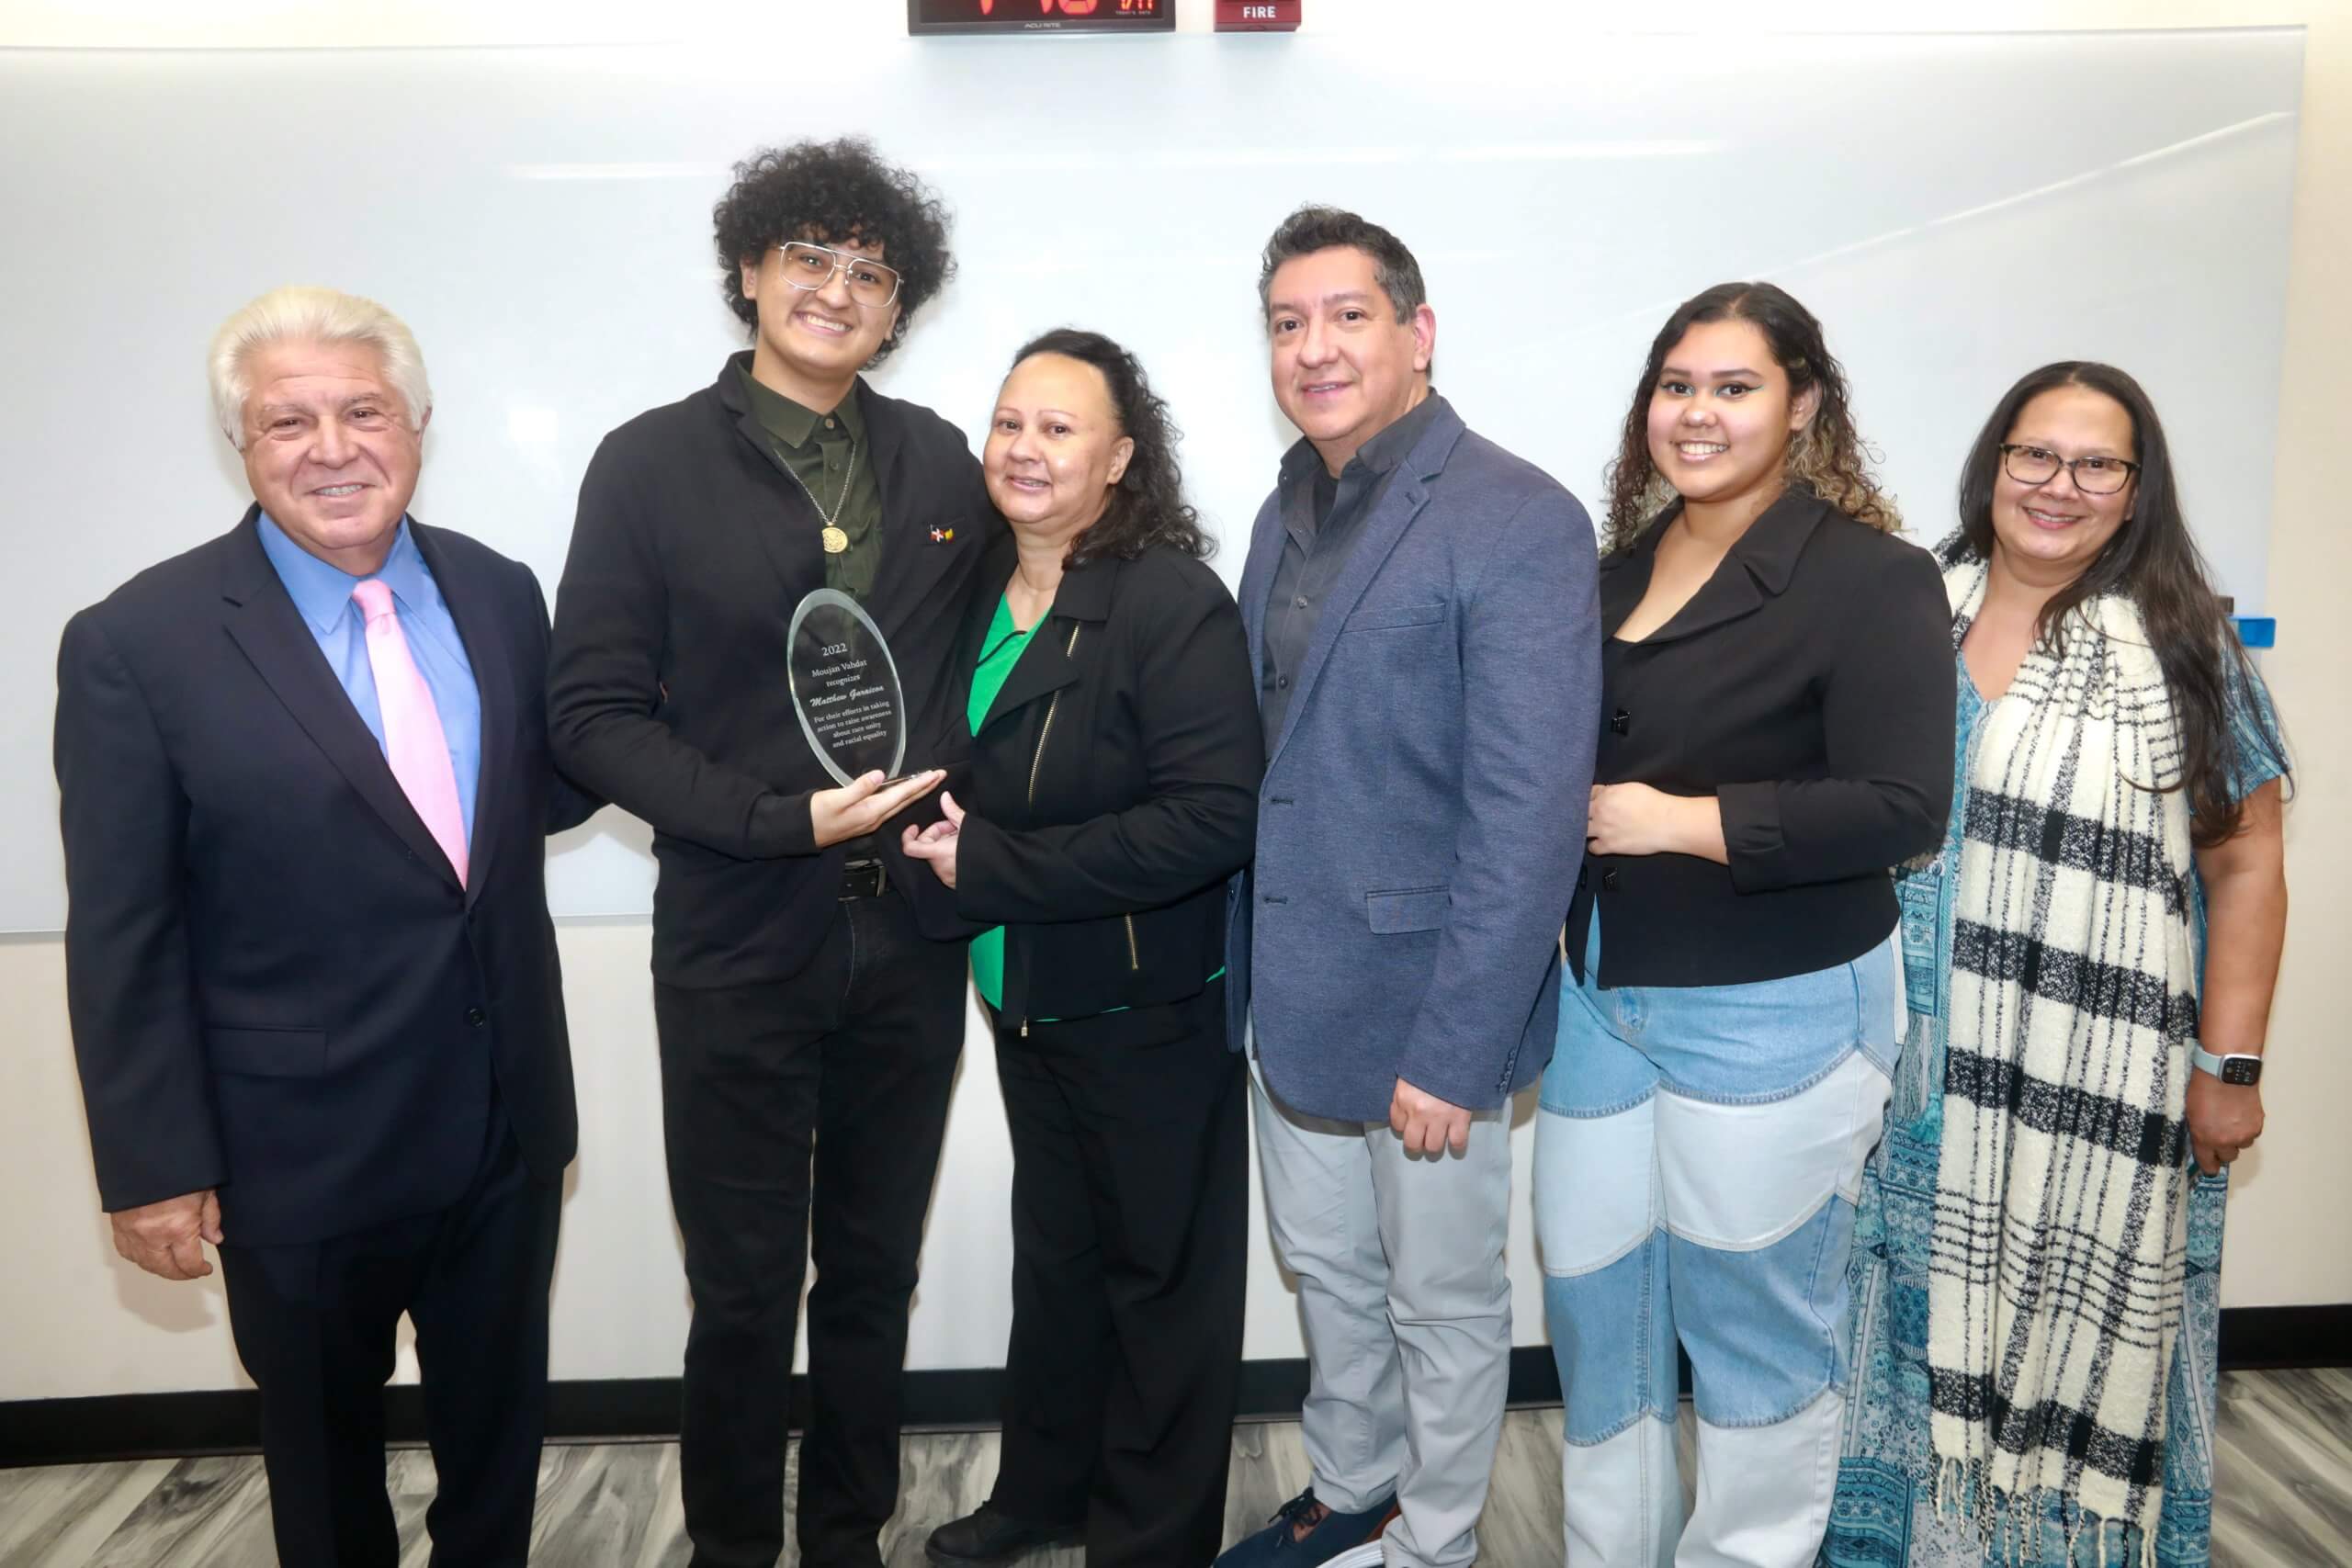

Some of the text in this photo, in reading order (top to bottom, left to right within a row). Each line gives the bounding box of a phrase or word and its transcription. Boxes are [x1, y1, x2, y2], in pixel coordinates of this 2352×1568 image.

[1243, 6, 1276, 18] FIRE
[821, 642, 848, 657] 2022
[826, 674, 861, 688] recognizes
[809, 693, 847, 707] Matthew
[825, 712, 842, 721] their
[842, 706, 863, 717] efforts
[863, 705, 871, 713] in
[870, 700, 890, 710] taking
[817, 723, 837, 734] action
[845, 716, 861, 726] raise
[861, 709, 893, 722] awareness
[833, 729, 852, 739] about
[865, 722, 882, 731] unity
[832, 730, 888, 749] and racial equality
